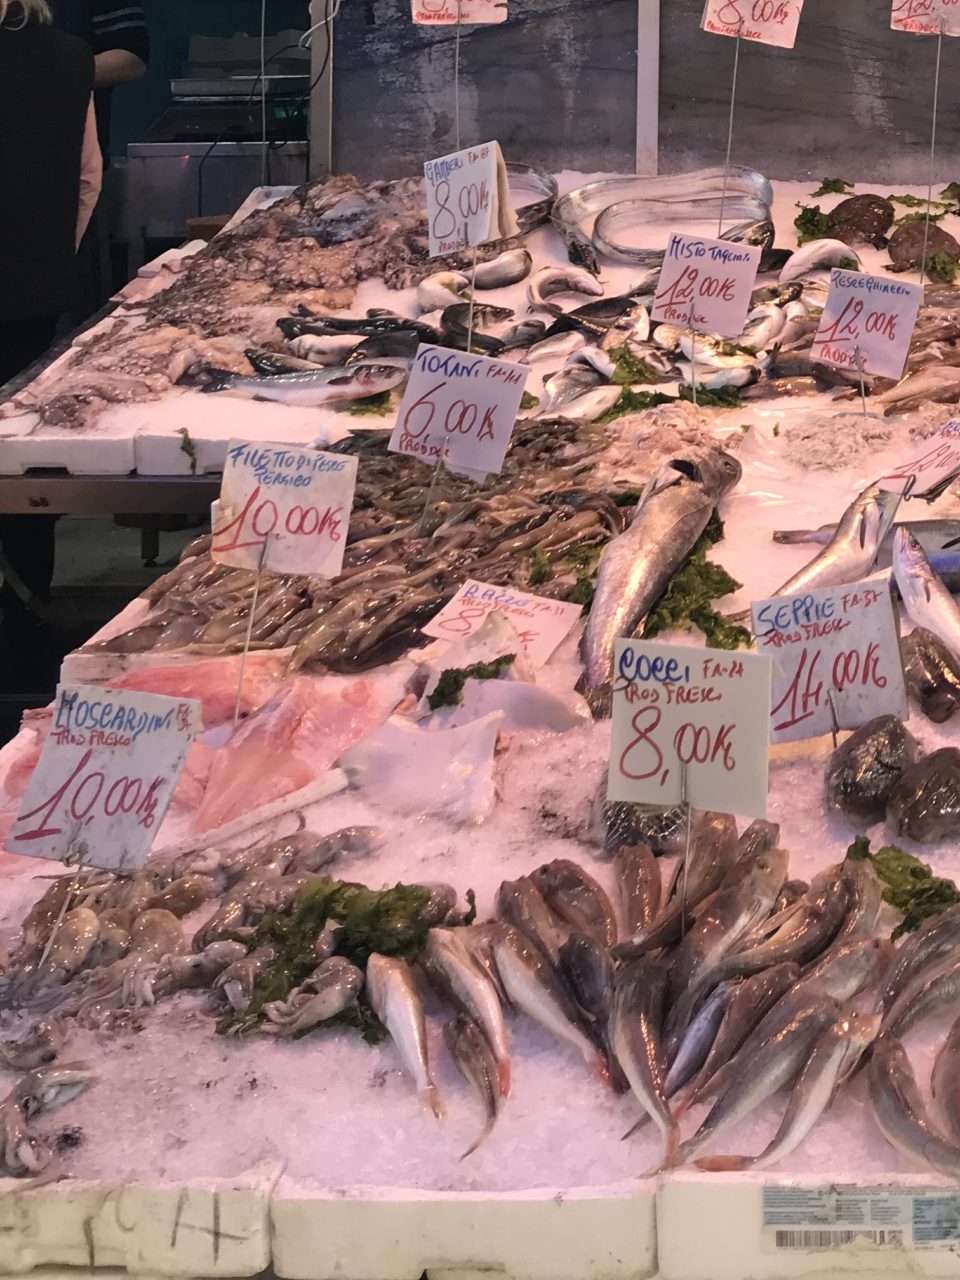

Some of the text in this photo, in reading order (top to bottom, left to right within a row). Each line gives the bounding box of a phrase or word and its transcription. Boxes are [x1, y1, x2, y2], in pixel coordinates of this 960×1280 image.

[669, 236, 706, 260] MISTO
[417, 348, 483, 377] TOTANI
[757, 594, 836, 637] SEPPIE
[619, 647, 690, 683] COCCI
[55, 689, 177, 741] MOSCARDINI
